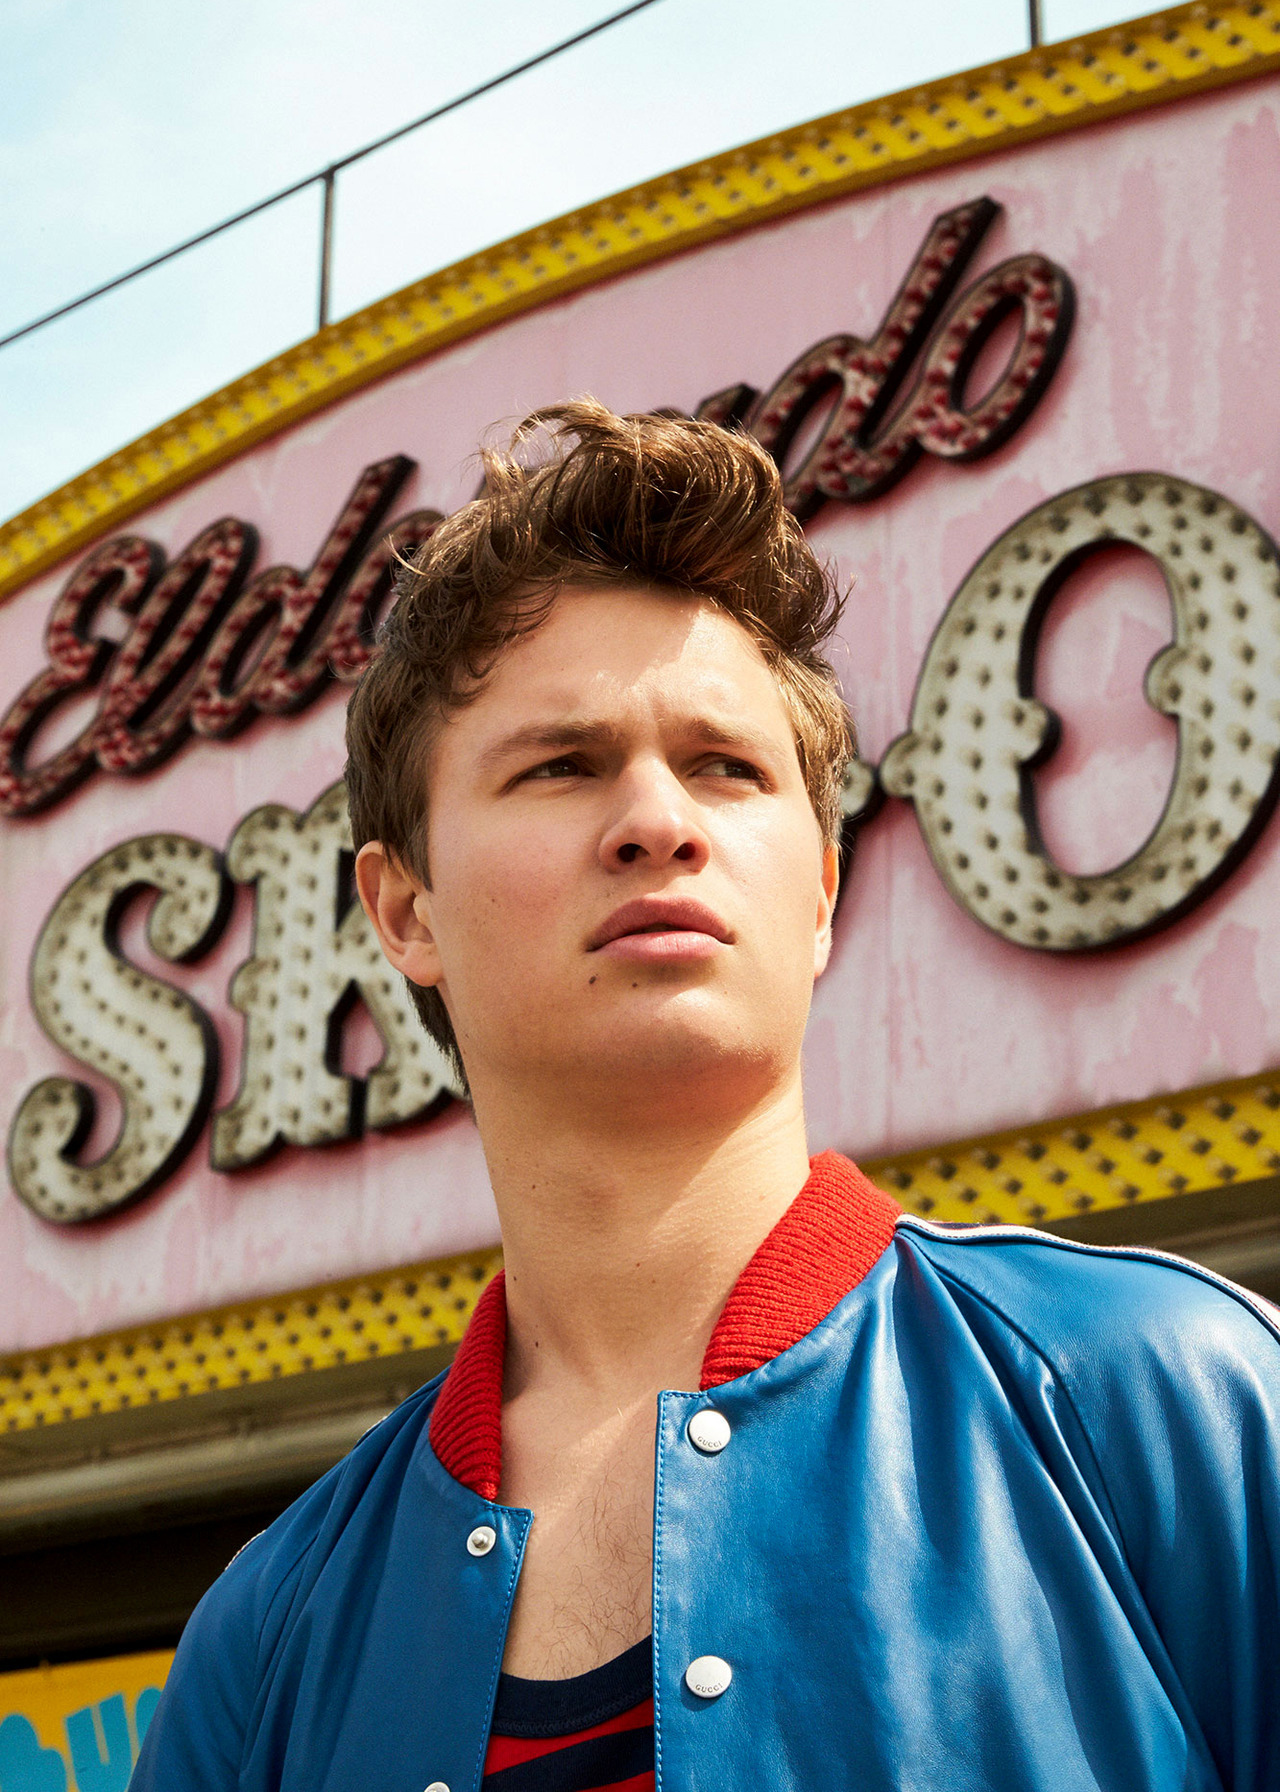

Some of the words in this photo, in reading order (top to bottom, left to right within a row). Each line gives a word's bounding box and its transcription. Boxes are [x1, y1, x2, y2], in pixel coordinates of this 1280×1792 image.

[8, 472, 1280, 1224] SKO
[697, 1436, 722, 1448] GUCCI
[695, 1682, 723, 1693] GUCCI
